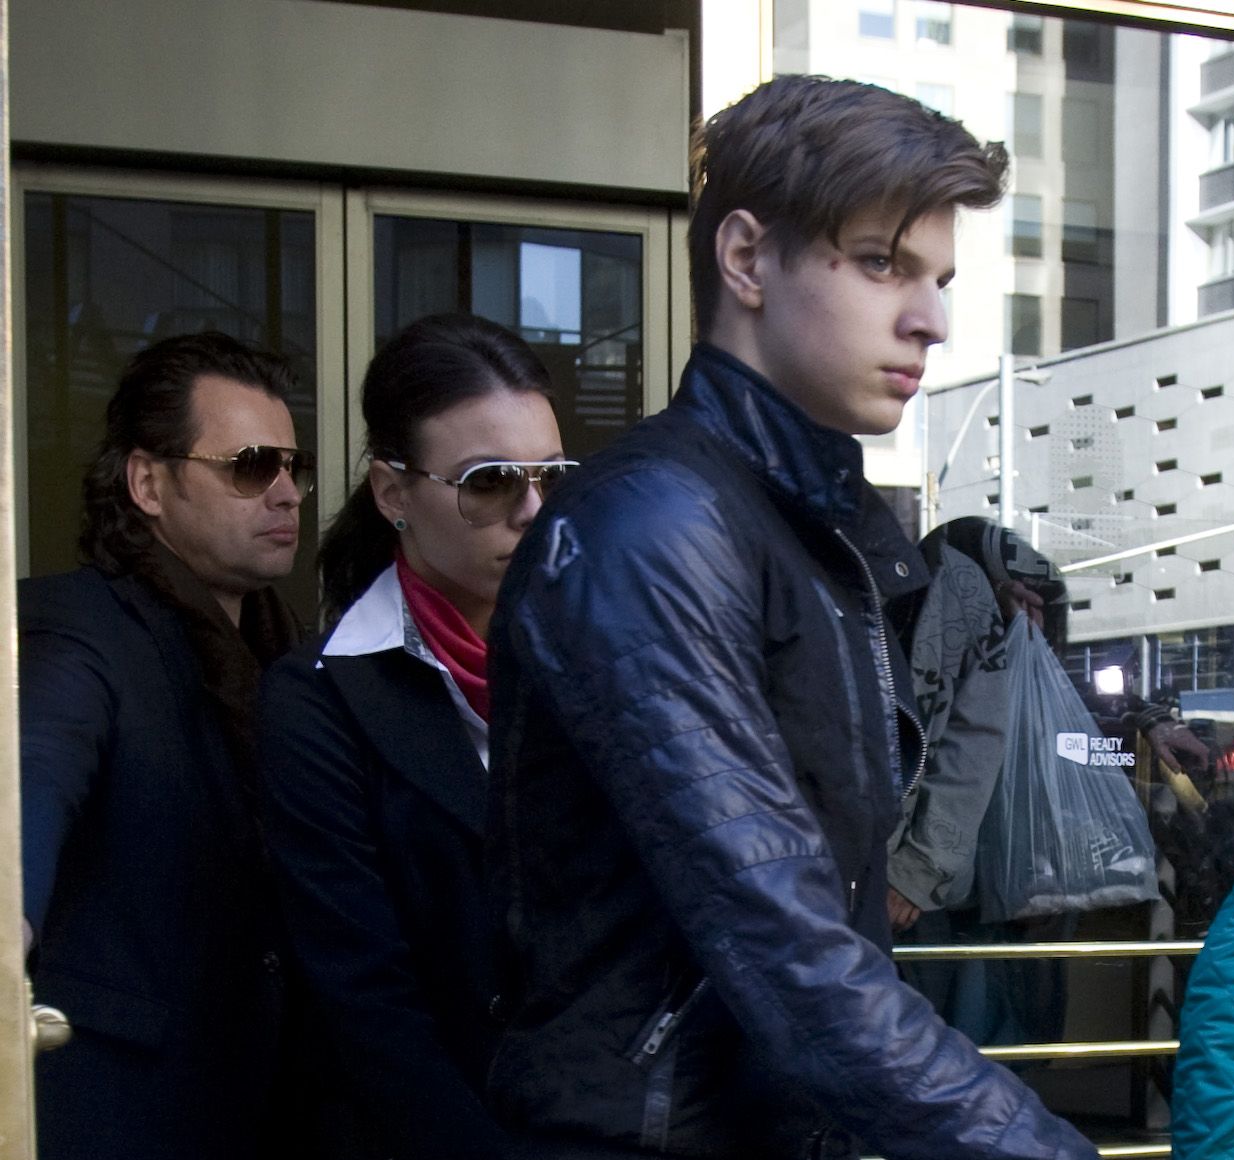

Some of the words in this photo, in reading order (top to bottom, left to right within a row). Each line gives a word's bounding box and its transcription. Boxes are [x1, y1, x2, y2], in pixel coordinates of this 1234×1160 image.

[1065, 737, 1086, 751] GWL
[1089, 737, 1124, 751] REALTY
[1089, 752, 1136, 767] ADVISORS
